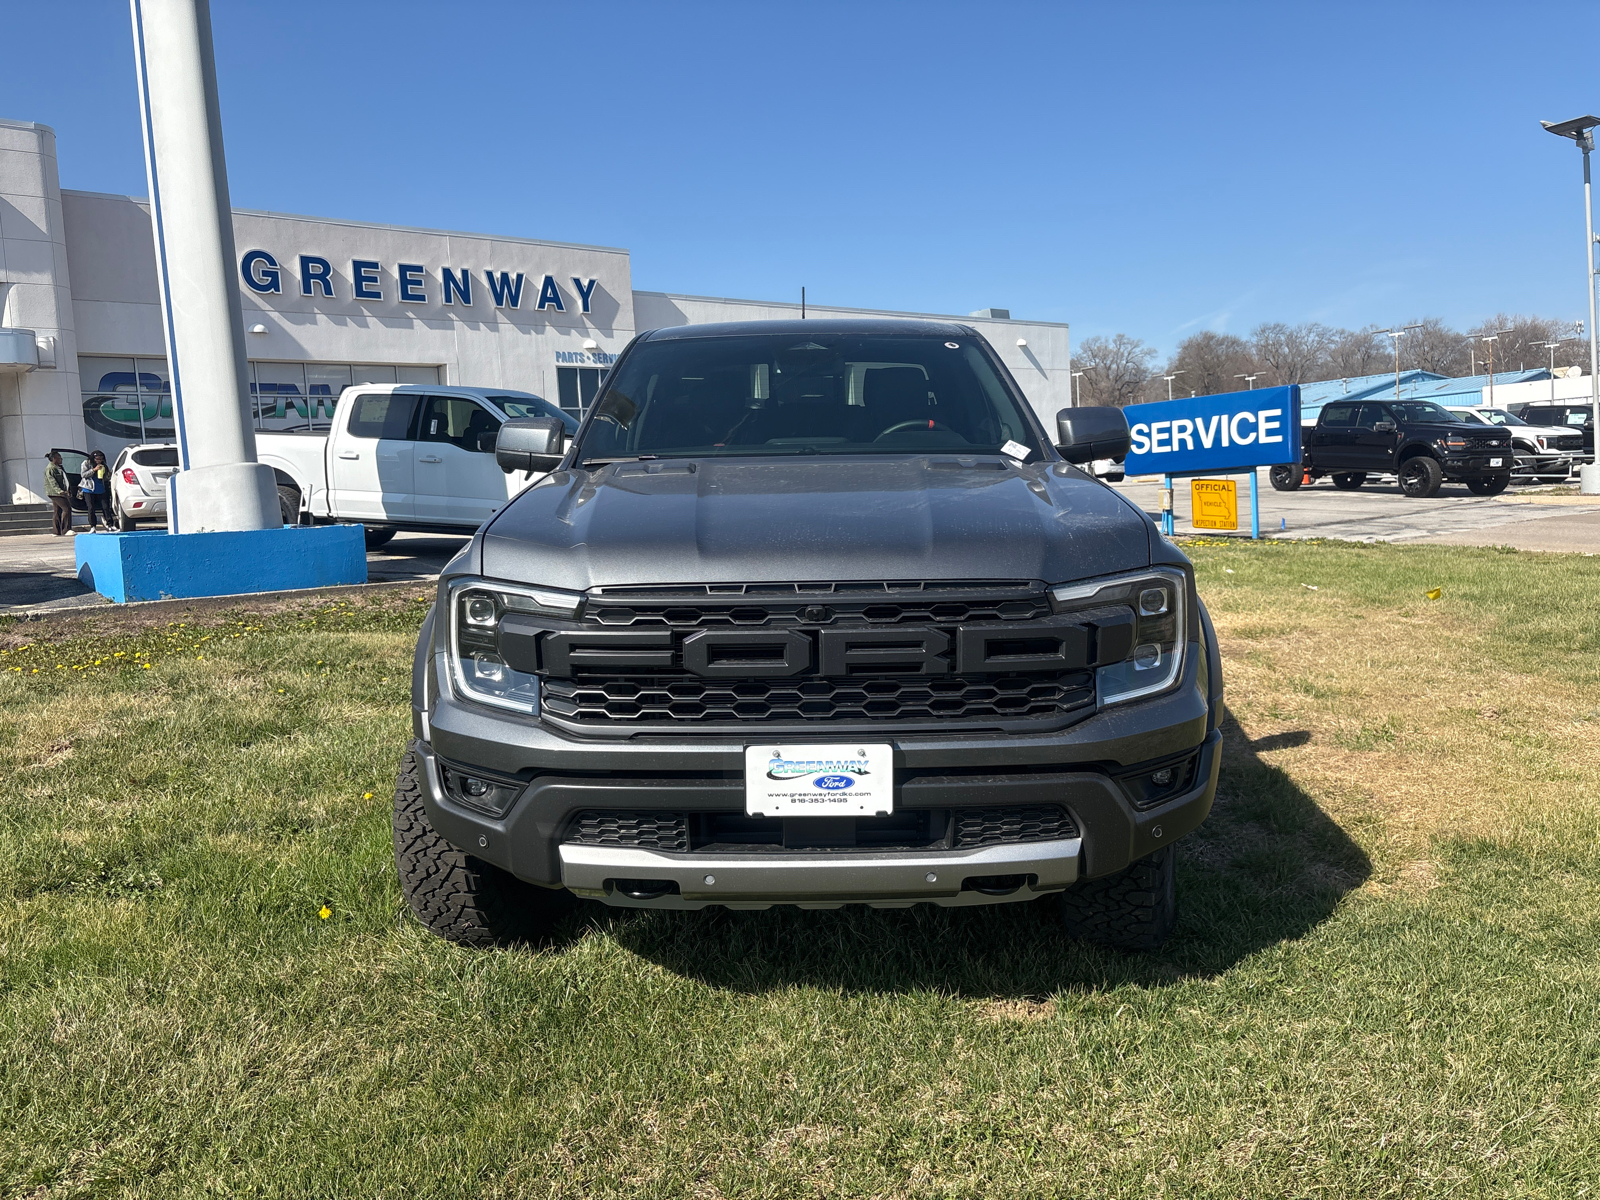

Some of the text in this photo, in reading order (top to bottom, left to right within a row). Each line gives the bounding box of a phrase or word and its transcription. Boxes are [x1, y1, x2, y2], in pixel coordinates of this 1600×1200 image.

[240, 249, 599, 315] GREENWAY
[555, 351, 621, 365] PARTS SERVI
[1130, 408, 1283, 455] SERVICE
[1195, 484, 1232, 492] OFFICIAL
[1219, 520, 1235, 528] STATION
[538, 625, 1090, 678] FORD
[768, 758, 870, 774] GREENWAY
[821, 776, 848, 788] Ford
